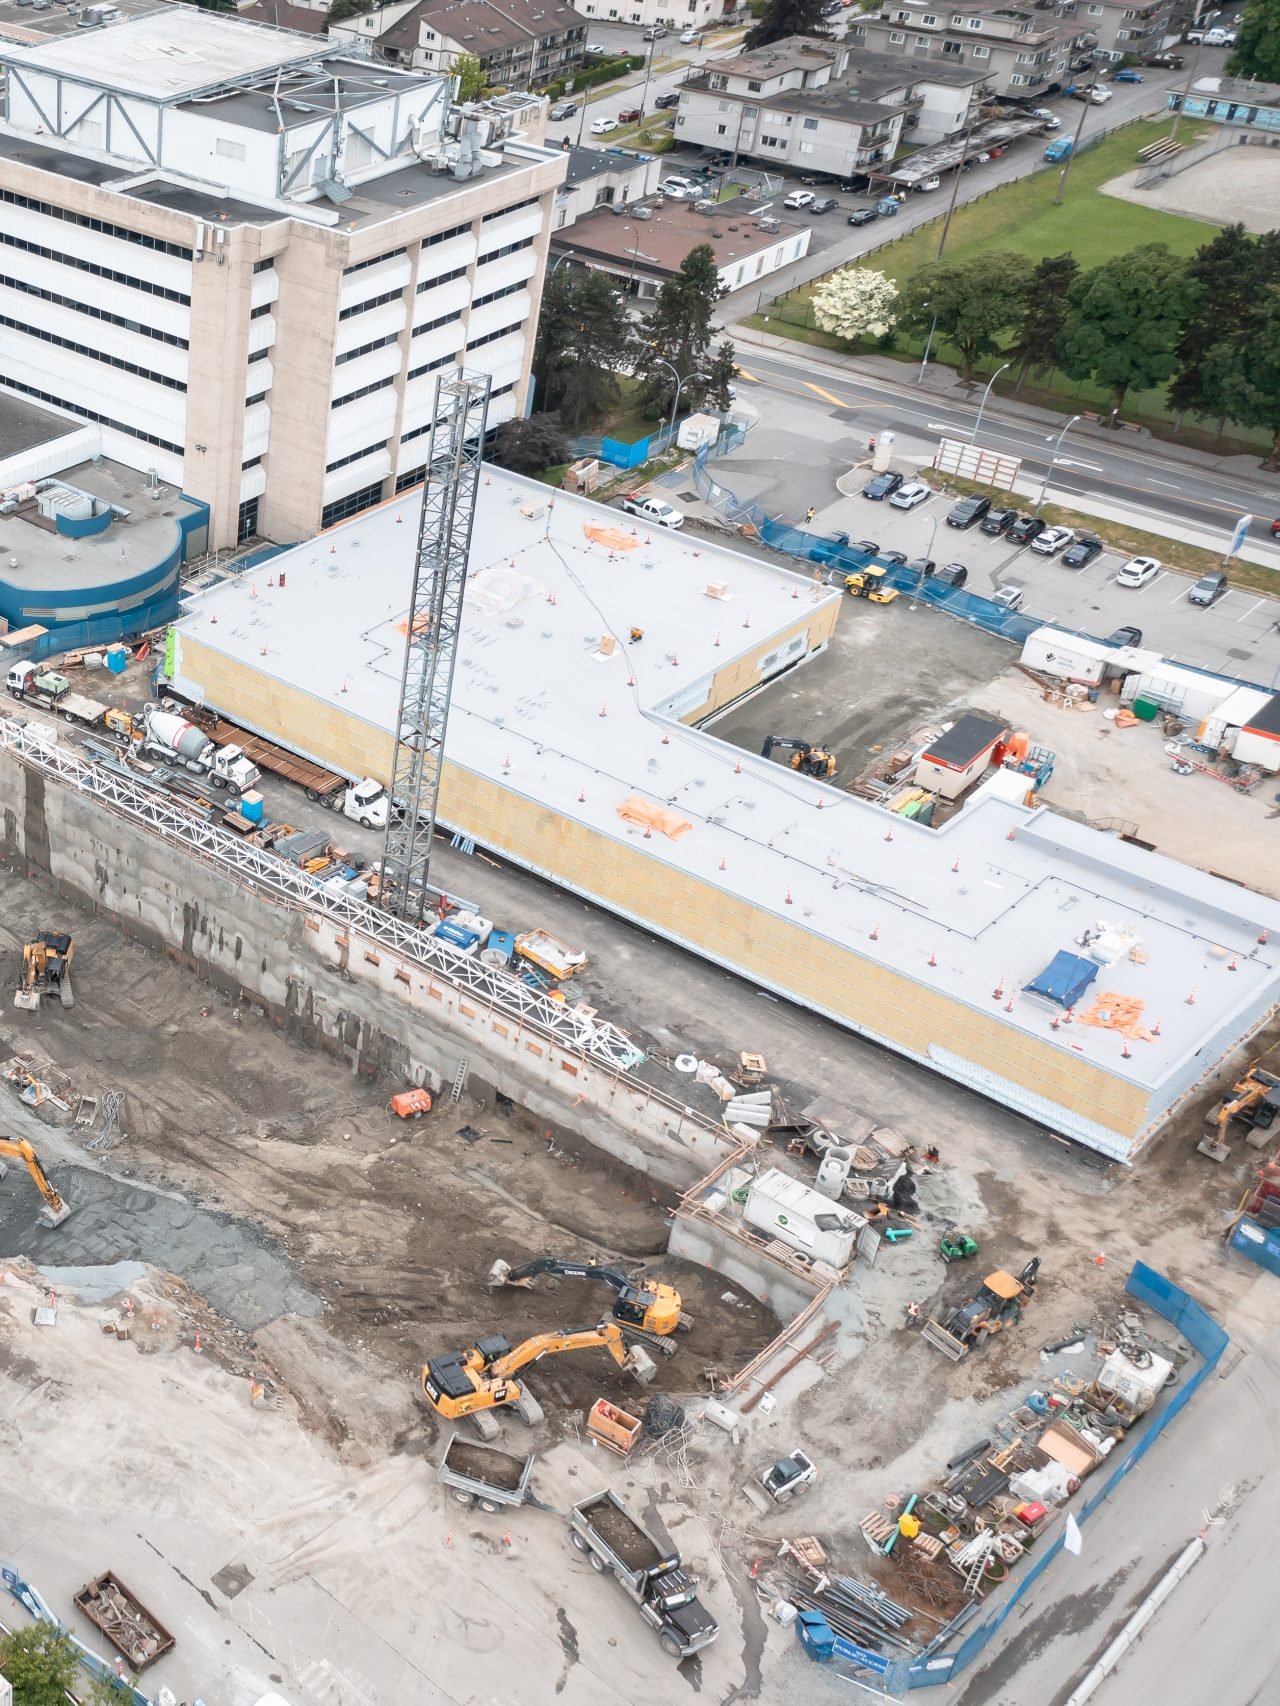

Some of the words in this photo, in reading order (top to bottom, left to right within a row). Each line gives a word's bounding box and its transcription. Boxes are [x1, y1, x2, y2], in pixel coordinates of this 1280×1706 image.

[158, 46, 187, 56] H
[426, 1381, 438, 1401] CAT
[495, 1389, 506, 1398] CAT
[835, 1644, 860, 1659] PUBLIC
[860, 1657, 886, 1670] ACCESS
[856, 1650, 867, 1658] NO
